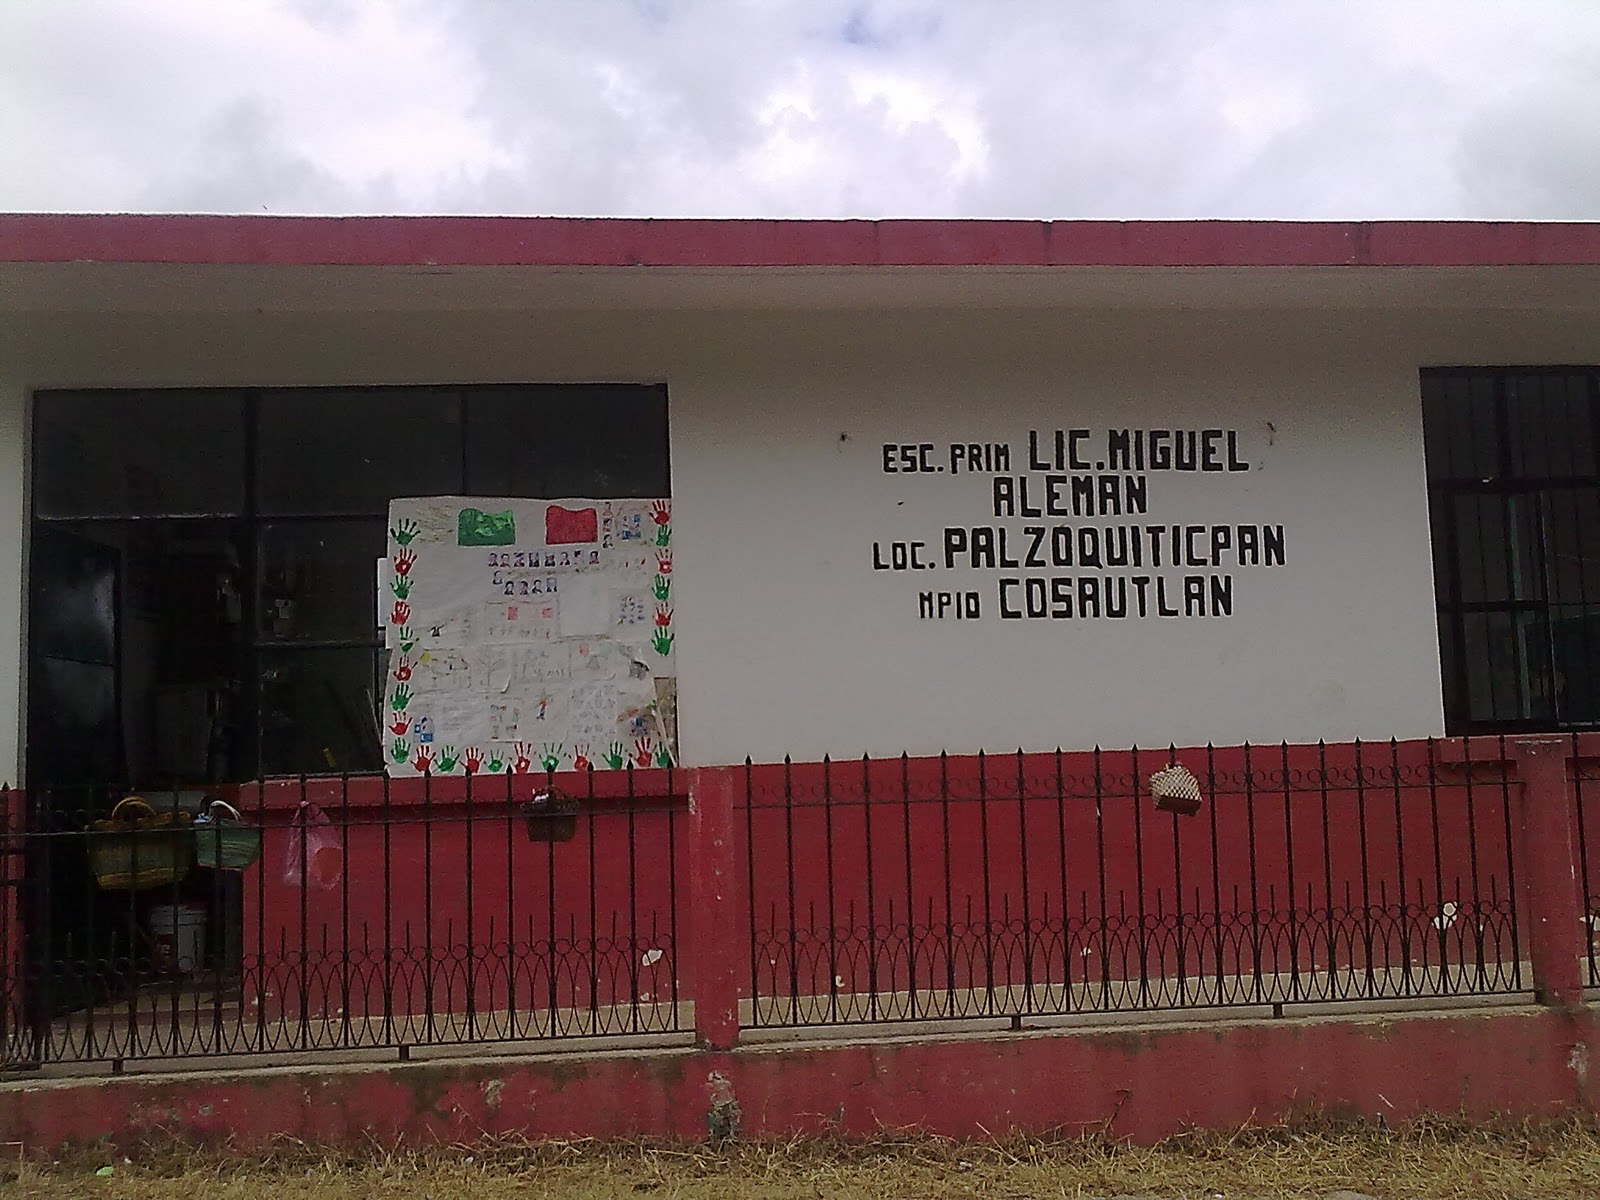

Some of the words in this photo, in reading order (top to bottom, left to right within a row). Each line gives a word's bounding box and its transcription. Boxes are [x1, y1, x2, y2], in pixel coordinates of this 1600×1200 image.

[993, 474, 1147, 518] ALEMAN
[872, 541, 936, 571] LOC.
[944, 524, 1286, 570] PALZOQUITICPAN
[998, 575, 1232, 619] COSAUTLAN
